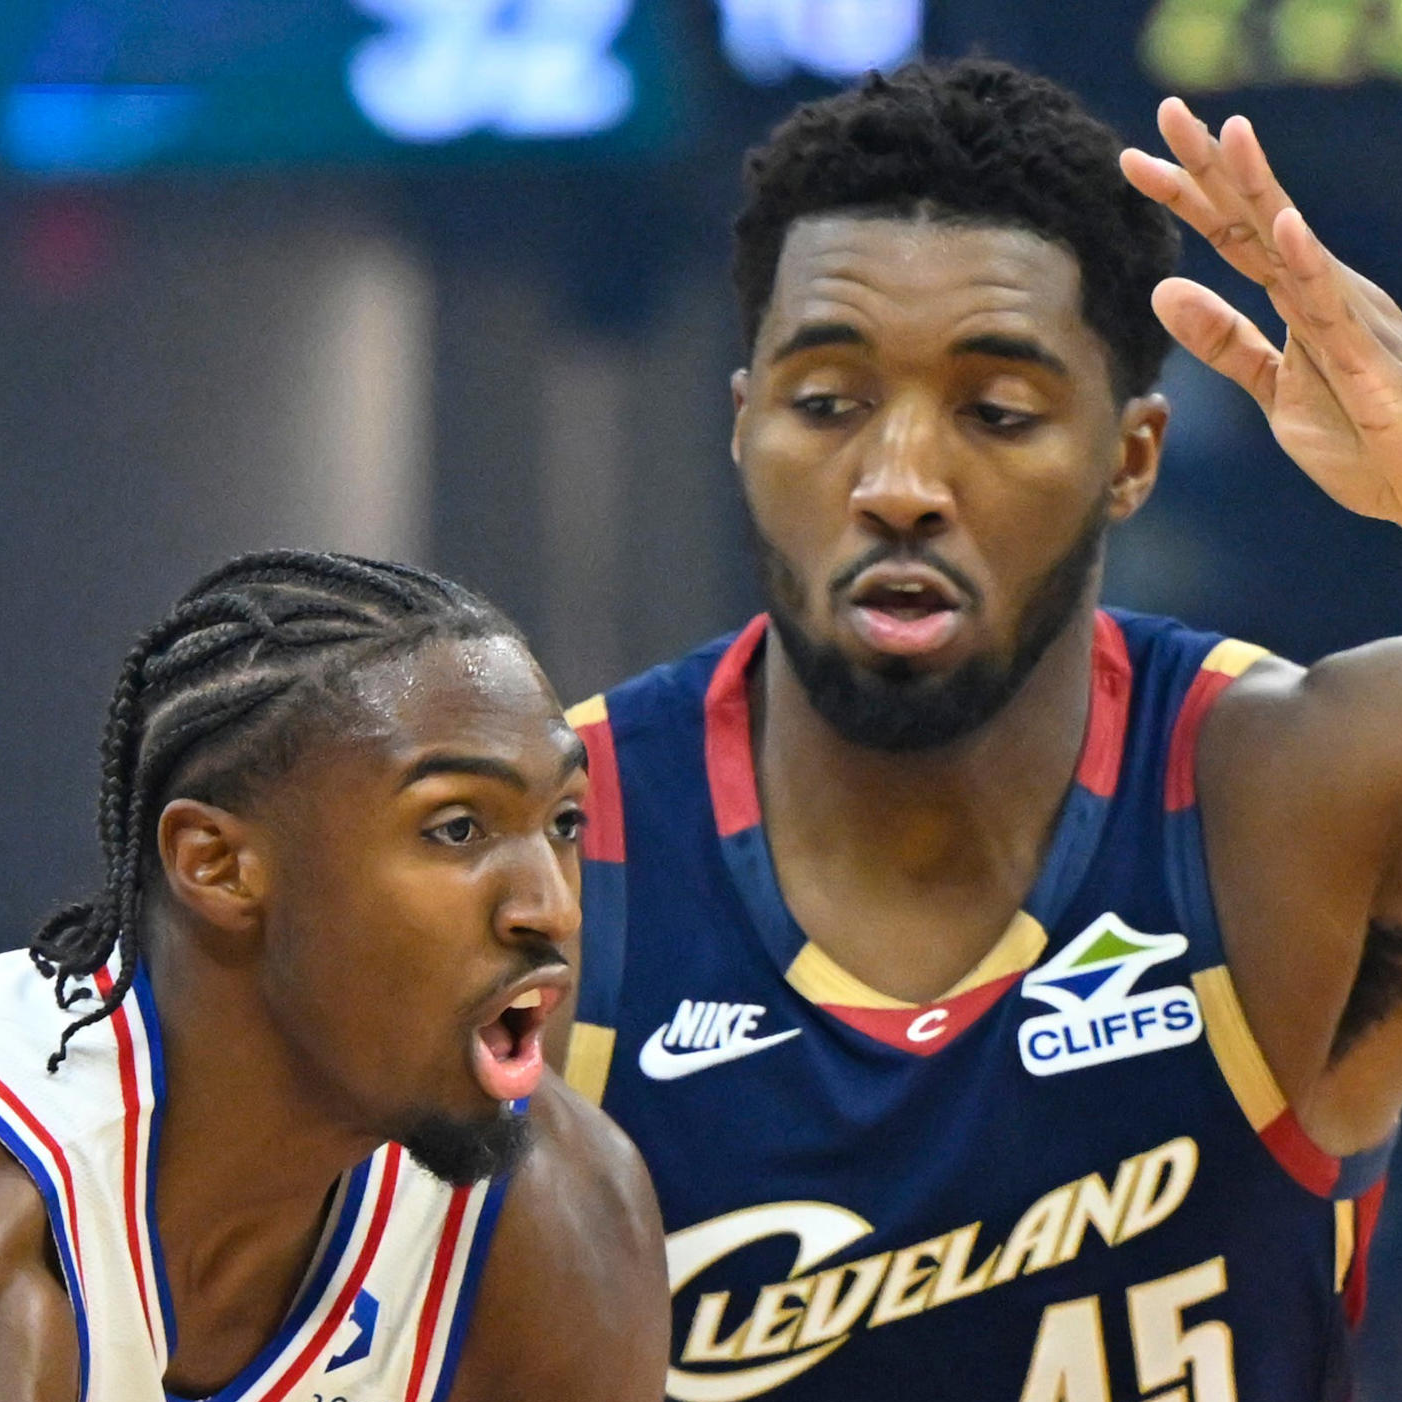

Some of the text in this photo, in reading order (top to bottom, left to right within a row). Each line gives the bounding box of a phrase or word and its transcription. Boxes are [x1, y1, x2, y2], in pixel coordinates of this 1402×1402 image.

[664, 1000, 766, 1048] NIKE
[906, 1008, 949, 1041] C
[1027, 1000, 1195, 1061] CLIFFS
